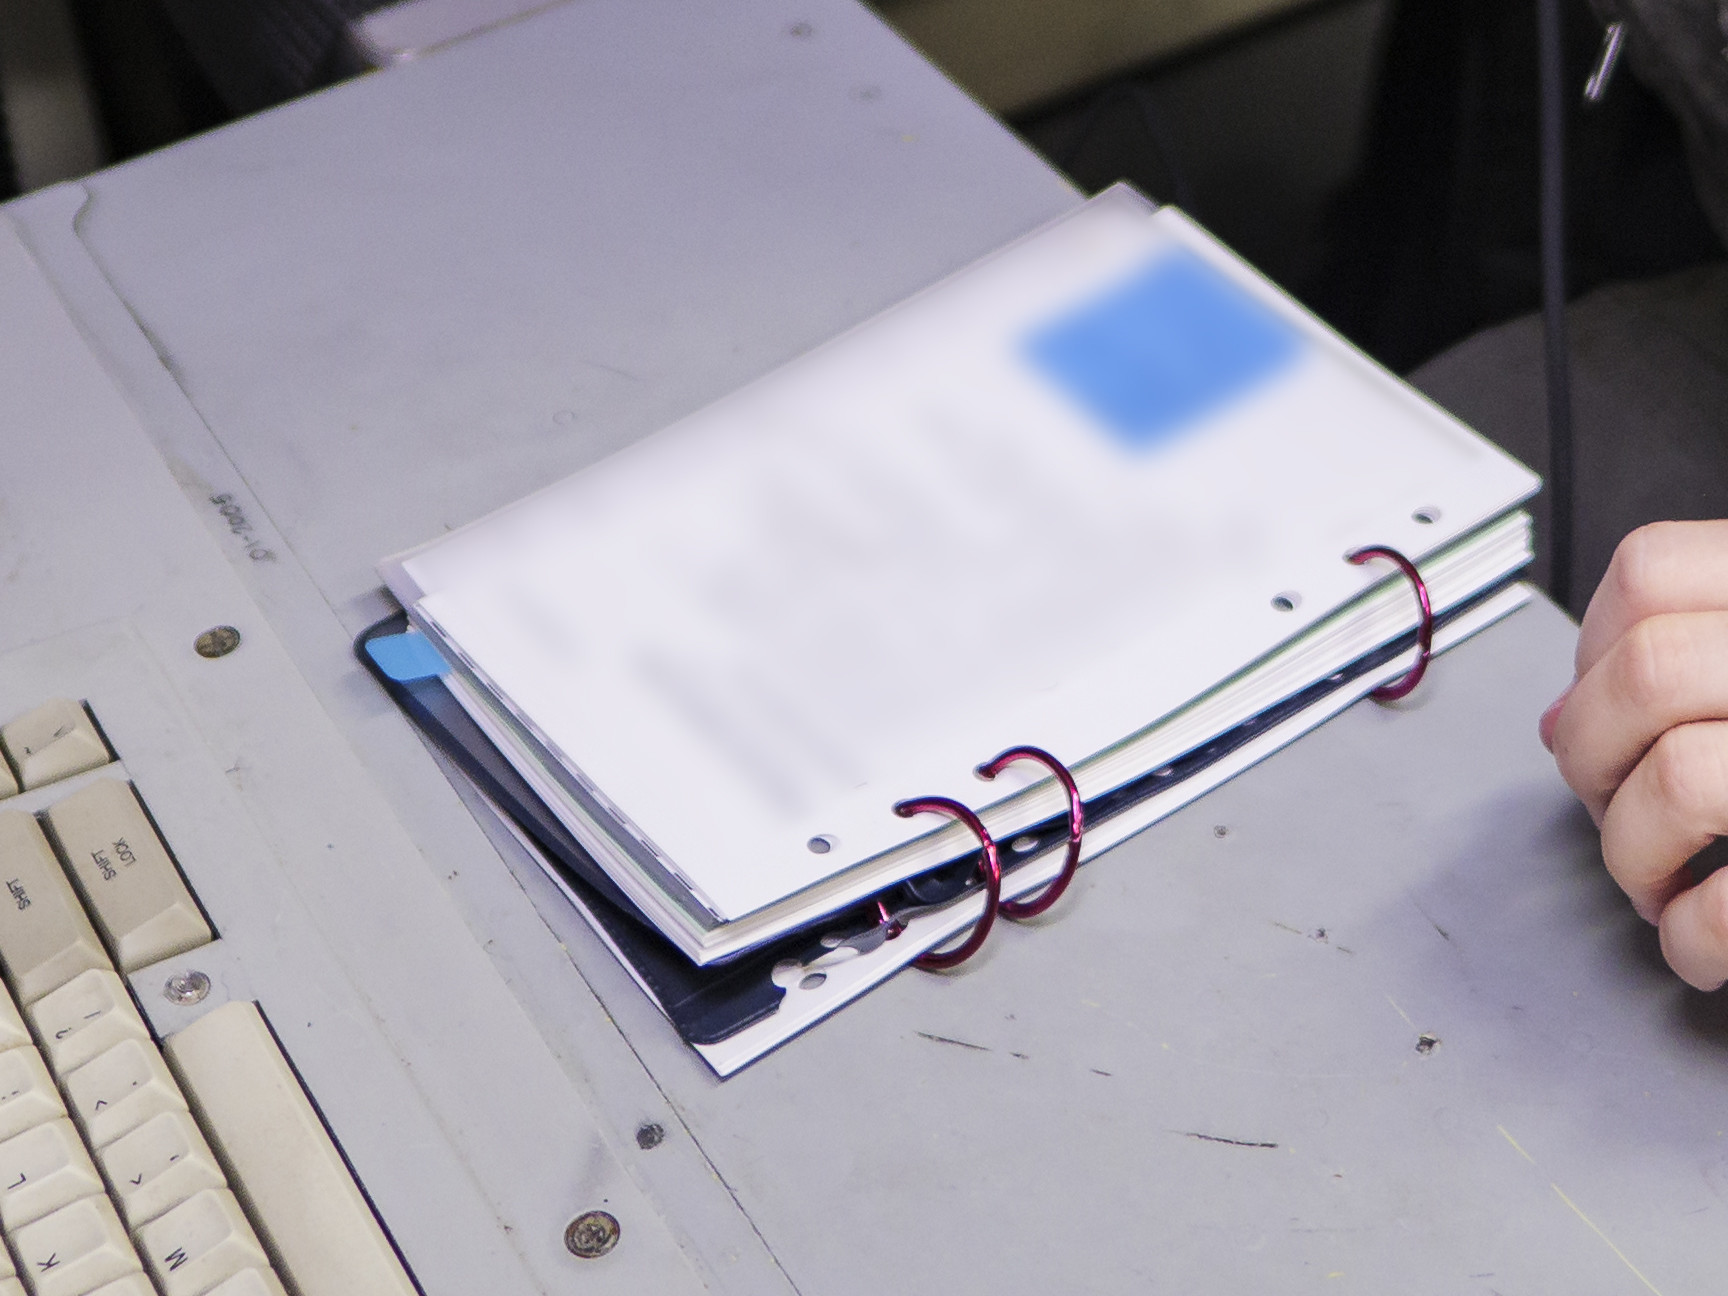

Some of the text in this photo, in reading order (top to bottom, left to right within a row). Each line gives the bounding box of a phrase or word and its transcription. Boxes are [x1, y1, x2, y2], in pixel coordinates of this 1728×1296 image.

[90, 848, 118, 882] SHIFT
[112, 837, 138, 869] LOCK
[5, 877, 32, 912] SHIFT
[6, 1172, 28, 1190] L
[36, 1251, 62, 1273] K
[164, 1246, 190, 1273] M
